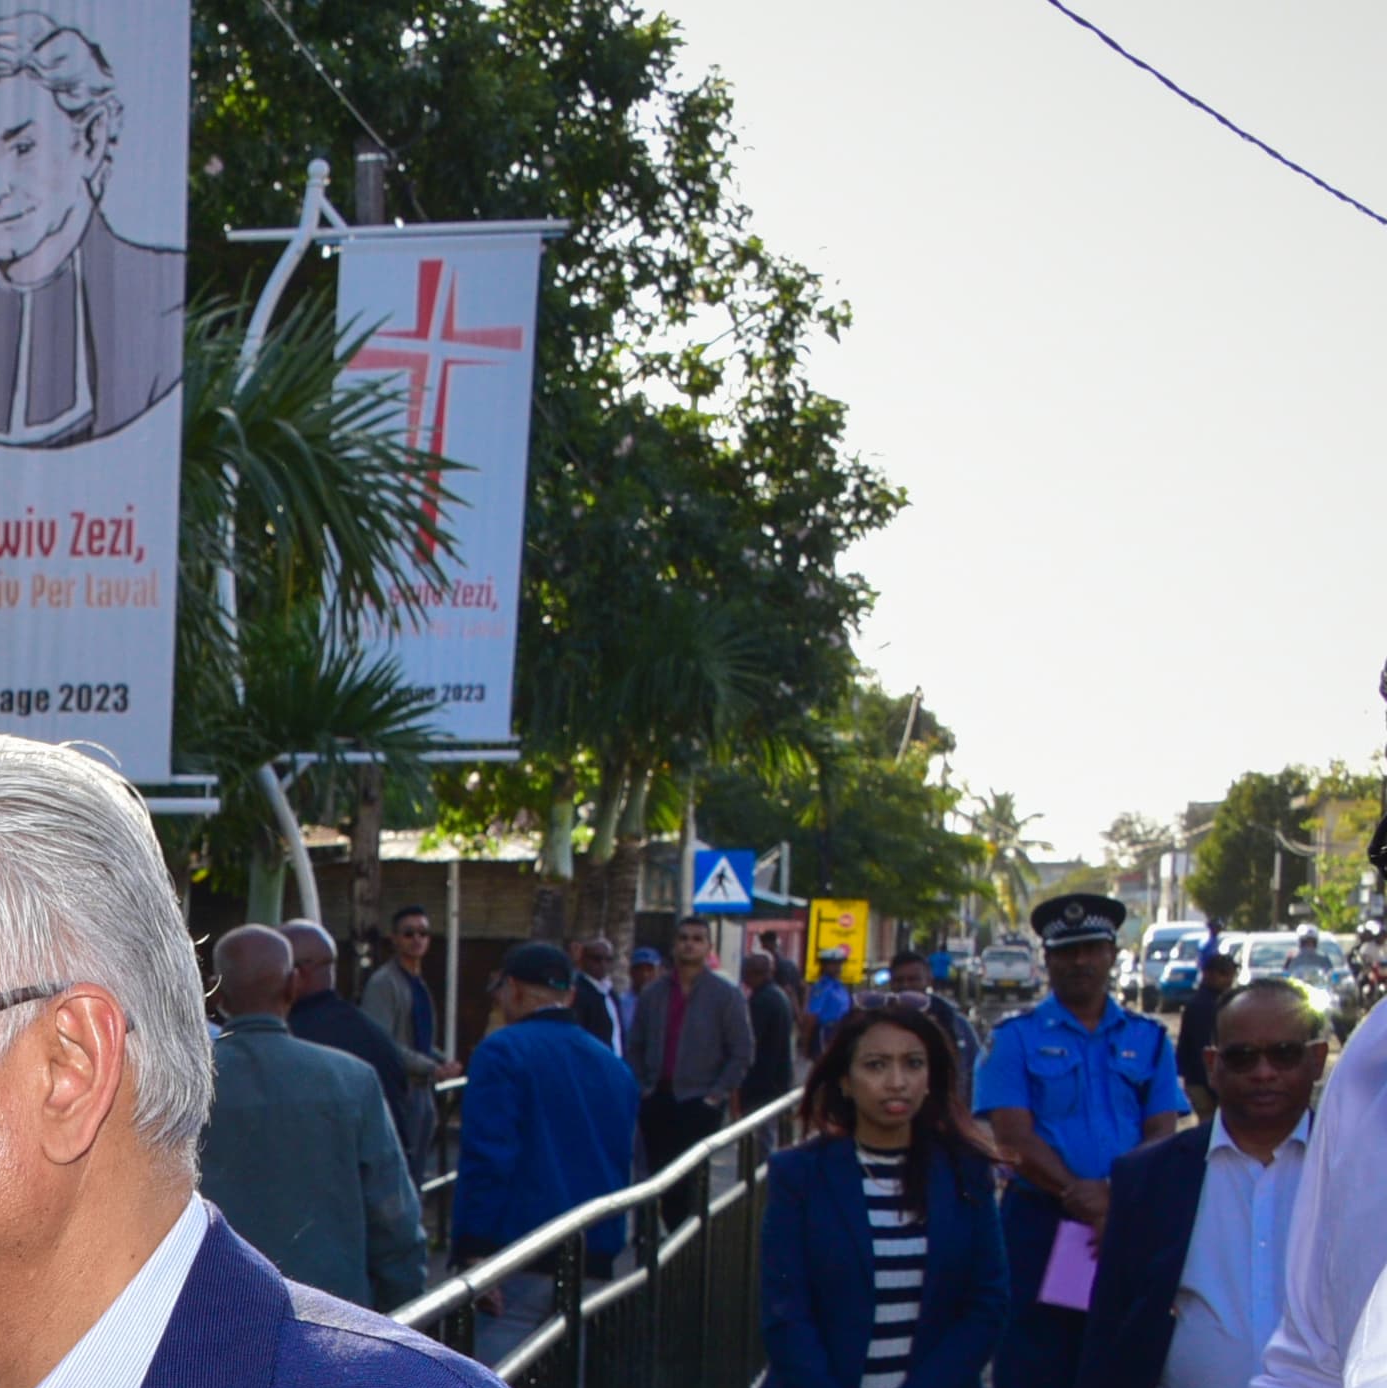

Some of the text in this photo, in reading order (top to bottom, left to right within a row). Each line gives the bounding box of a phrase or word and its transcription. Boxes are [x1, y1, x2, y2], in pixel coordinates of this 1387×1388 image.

[68, 504, 145, 564] Zezi,
[30, 573, 77, 608] Per
[85, 568, 159, 608] Laval
[450, 575, 499, 613] Zezi,
[58, 683, 130, 713] 2023
[441, 683, 486, 702] 2023
